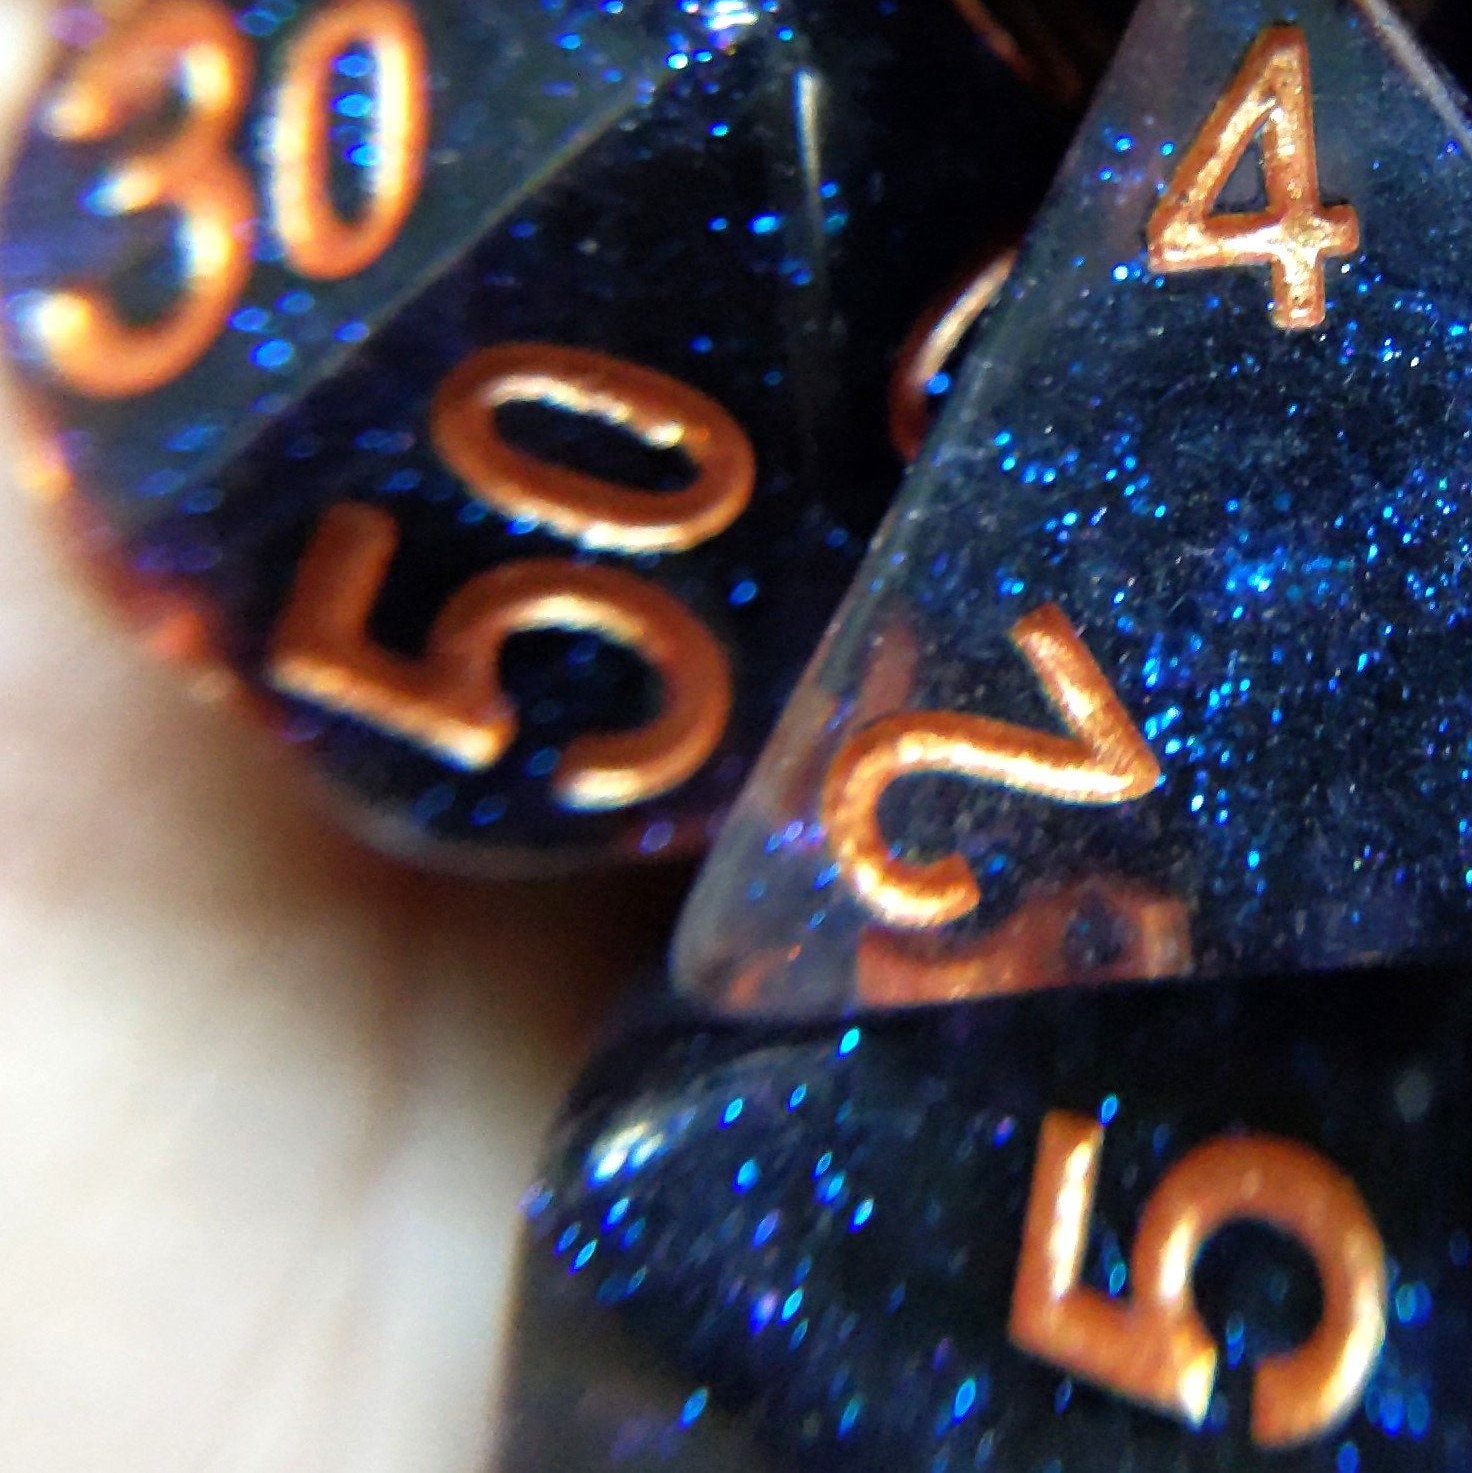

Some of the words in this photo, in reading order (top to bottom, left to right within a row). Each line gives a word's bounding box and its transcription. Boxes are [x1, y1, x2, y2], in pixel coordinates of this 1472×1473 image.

[1147, 23, 1360, 329] 4
[266, 342, 757, 814] 50
[823, 602, 1160, 927] 2
[1008, 1109, 1388, 1449] 5
